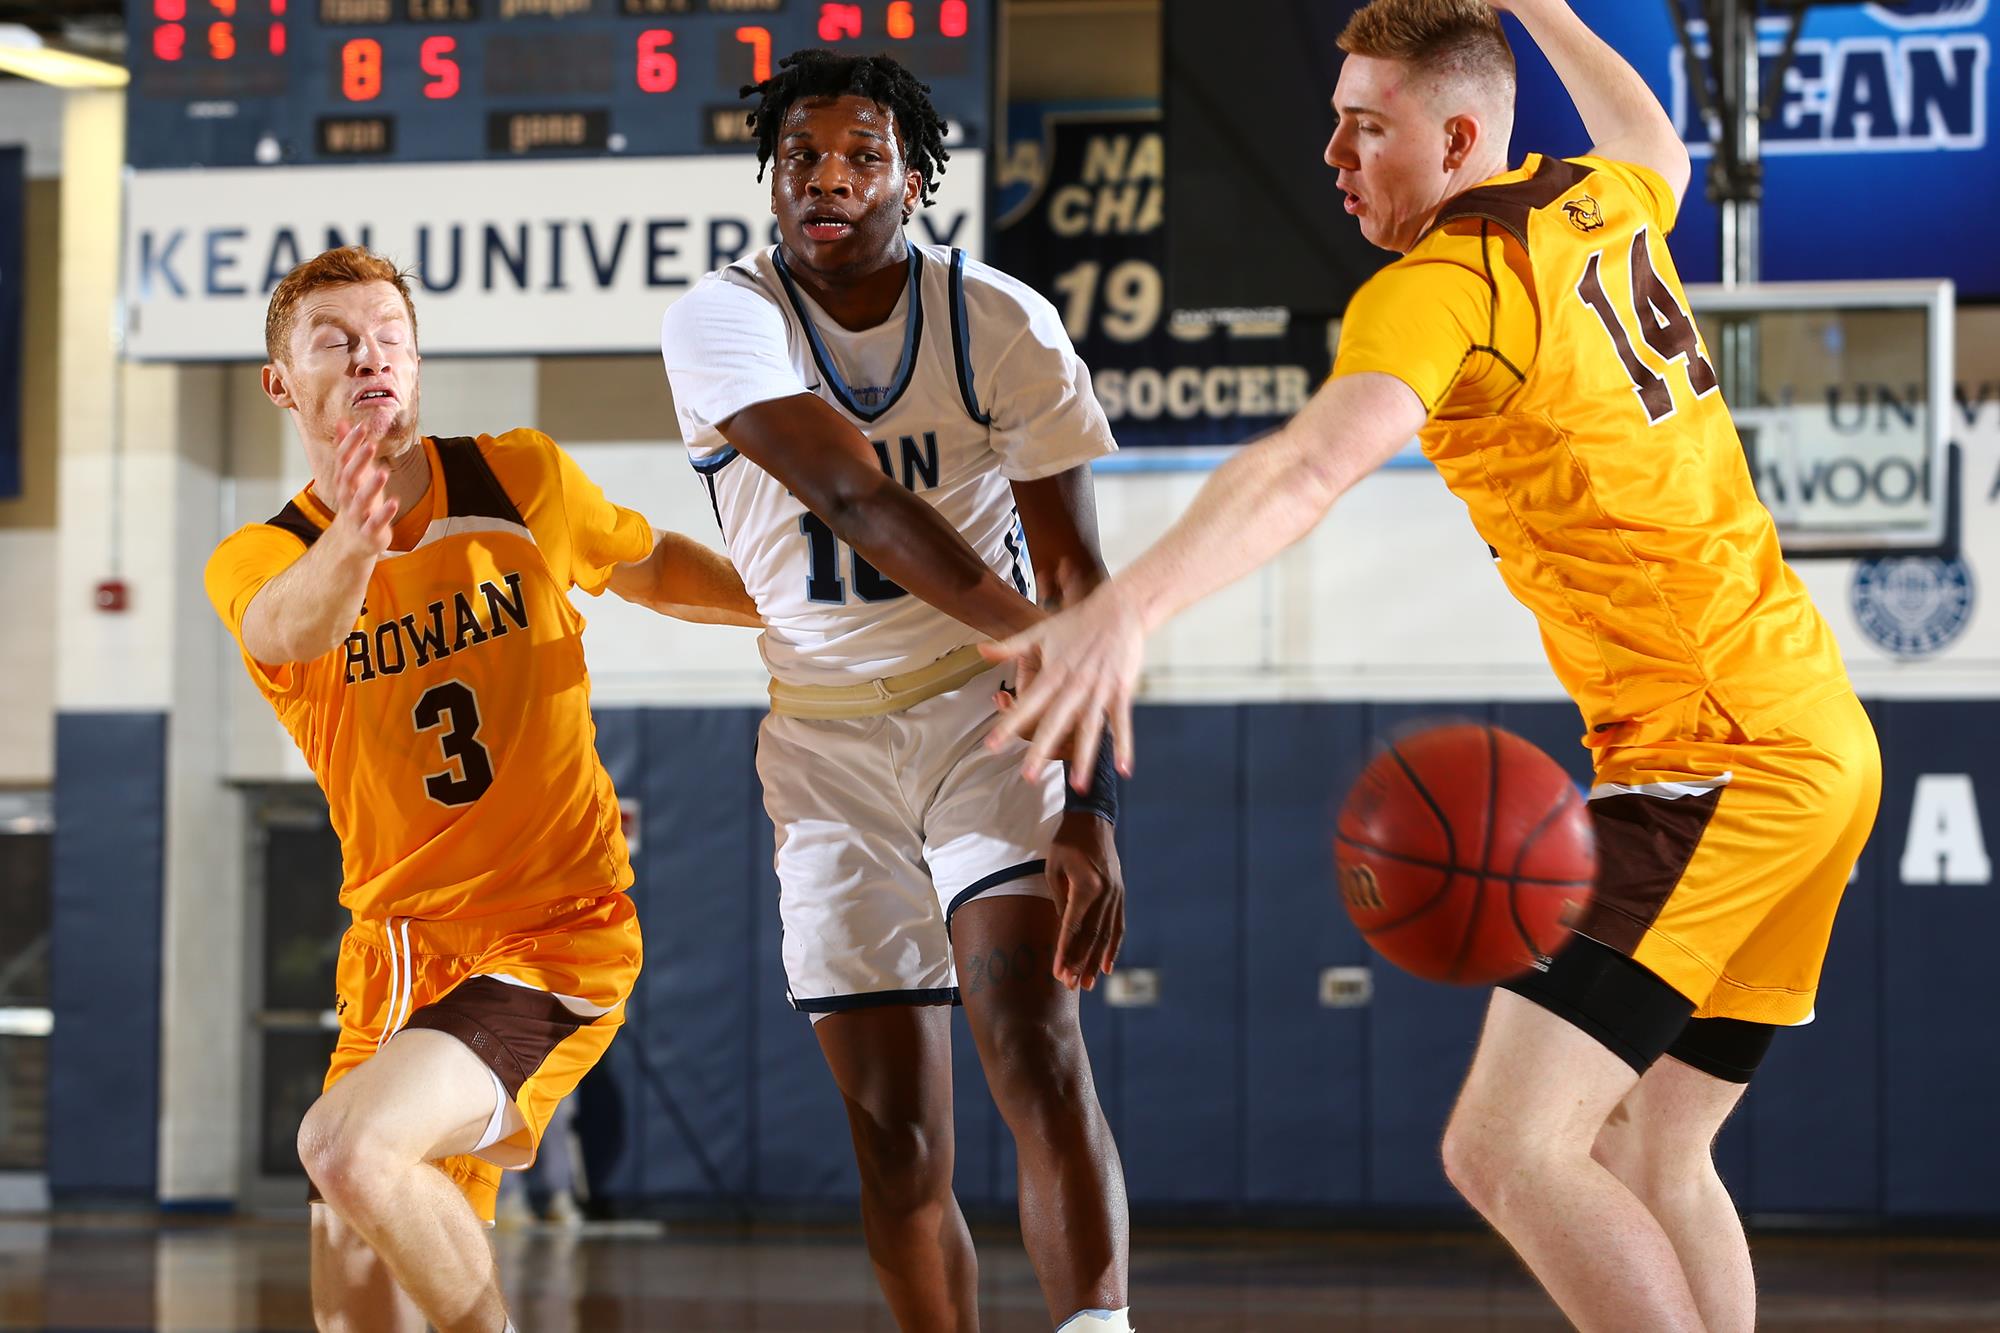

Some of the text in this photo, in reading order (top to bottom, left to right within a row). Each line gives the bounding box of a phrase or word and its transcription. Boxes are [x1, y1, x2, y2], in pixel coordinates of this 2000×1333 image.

[342, 36, 460, 101] 8 5
[636, 26, 771, 93] 6 7
[1575, 225, 1718, 427] 14
[1100, 366, 1311, 421] SOCCER
[345, 571, 529, 686] ROWAN
[411, 677, 496, 808] 3
